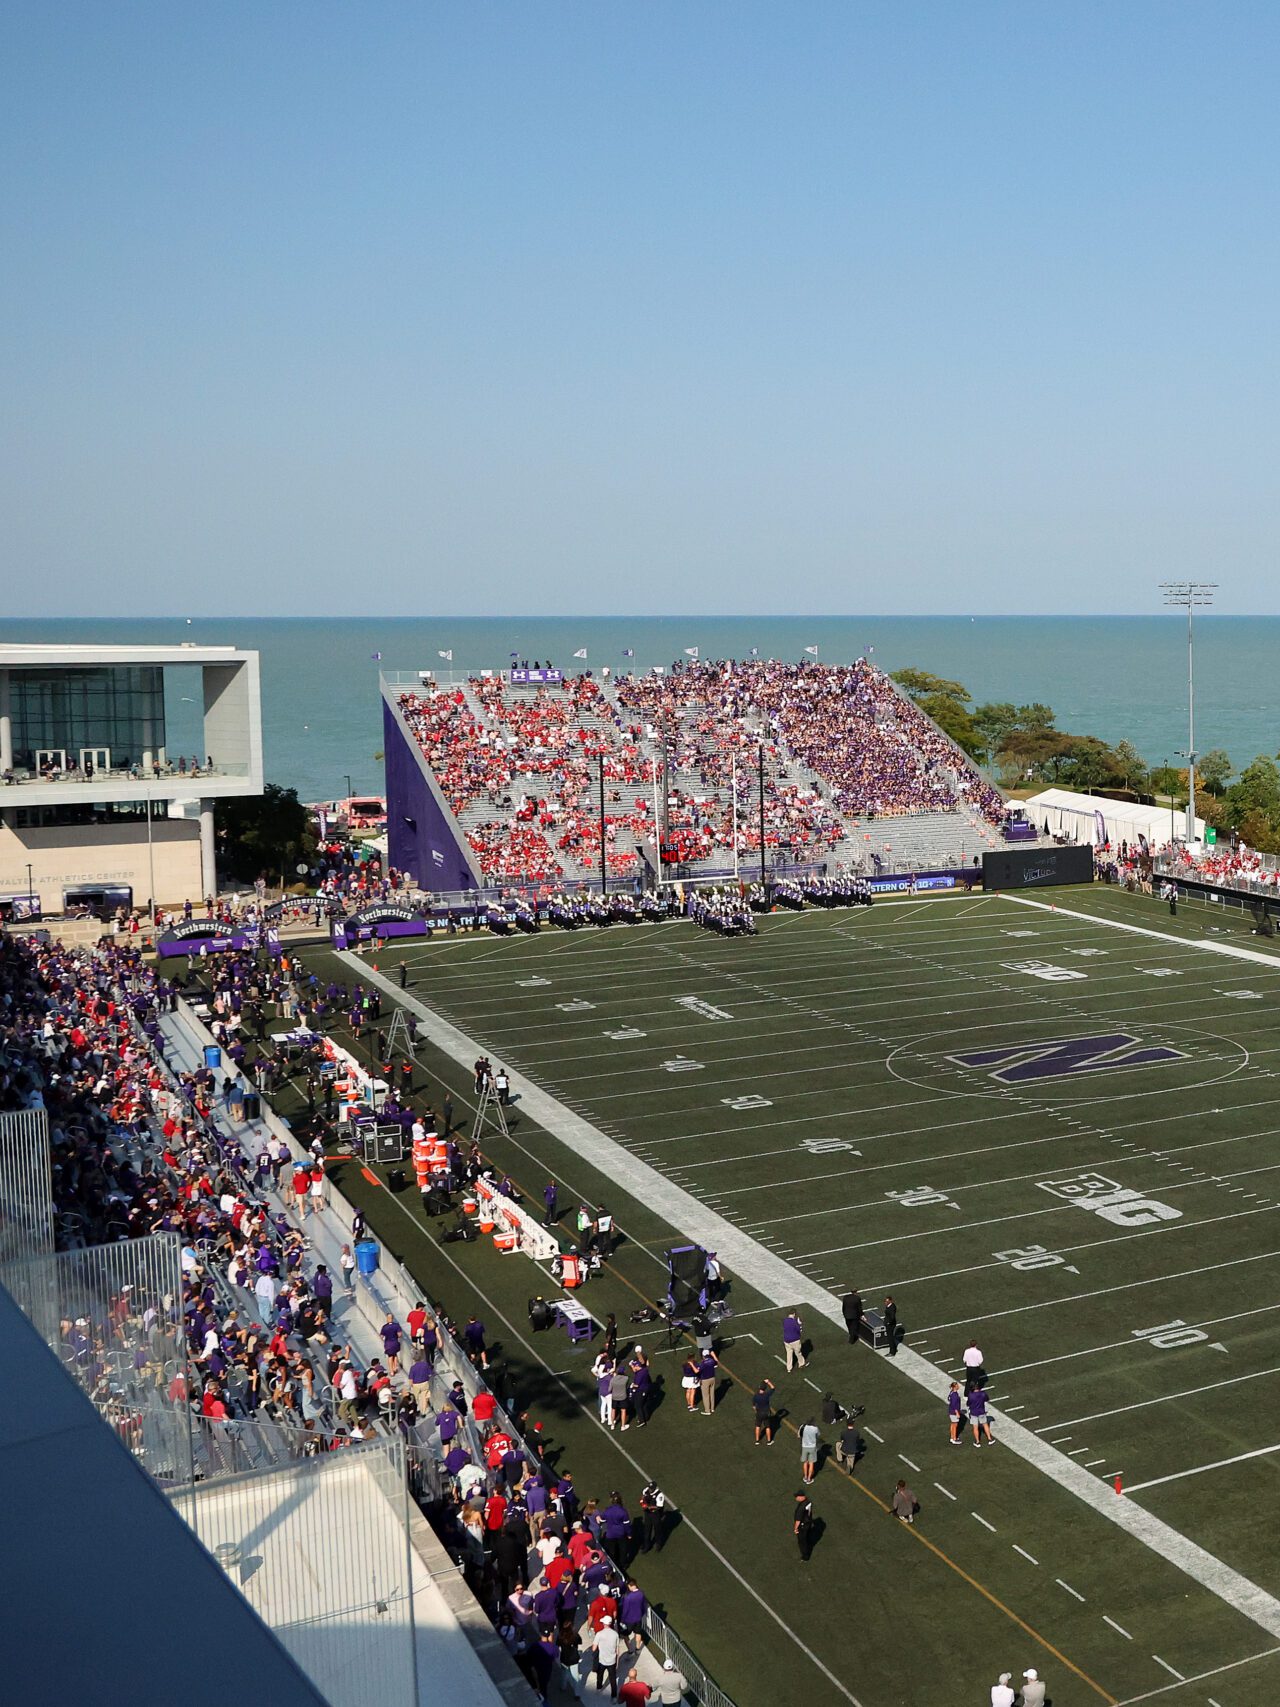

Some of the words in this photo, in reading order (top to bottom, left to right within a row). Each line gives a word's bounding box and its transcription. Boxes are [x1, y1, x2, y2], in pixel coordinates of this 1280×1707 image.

[39, 871, 94, 884] ATHLETICS
[96, 871, 135, 881] CENTER
[358, 908, 413, 924] Northwestern
[173, 922, 233, 940] Northwestern
[268, 929, 279, 943] N
[334, 923, 345, 937] N
[944, 1032, 1193, 1084] N
[720, 1094, 774, 1110] 50
[799, 1138, 853, 1154] 40
[884, 1185, 950, 1208] 30
[991, 1244, 1066, 1271] 20
[1131, 1319, 1209, 1349] 10
